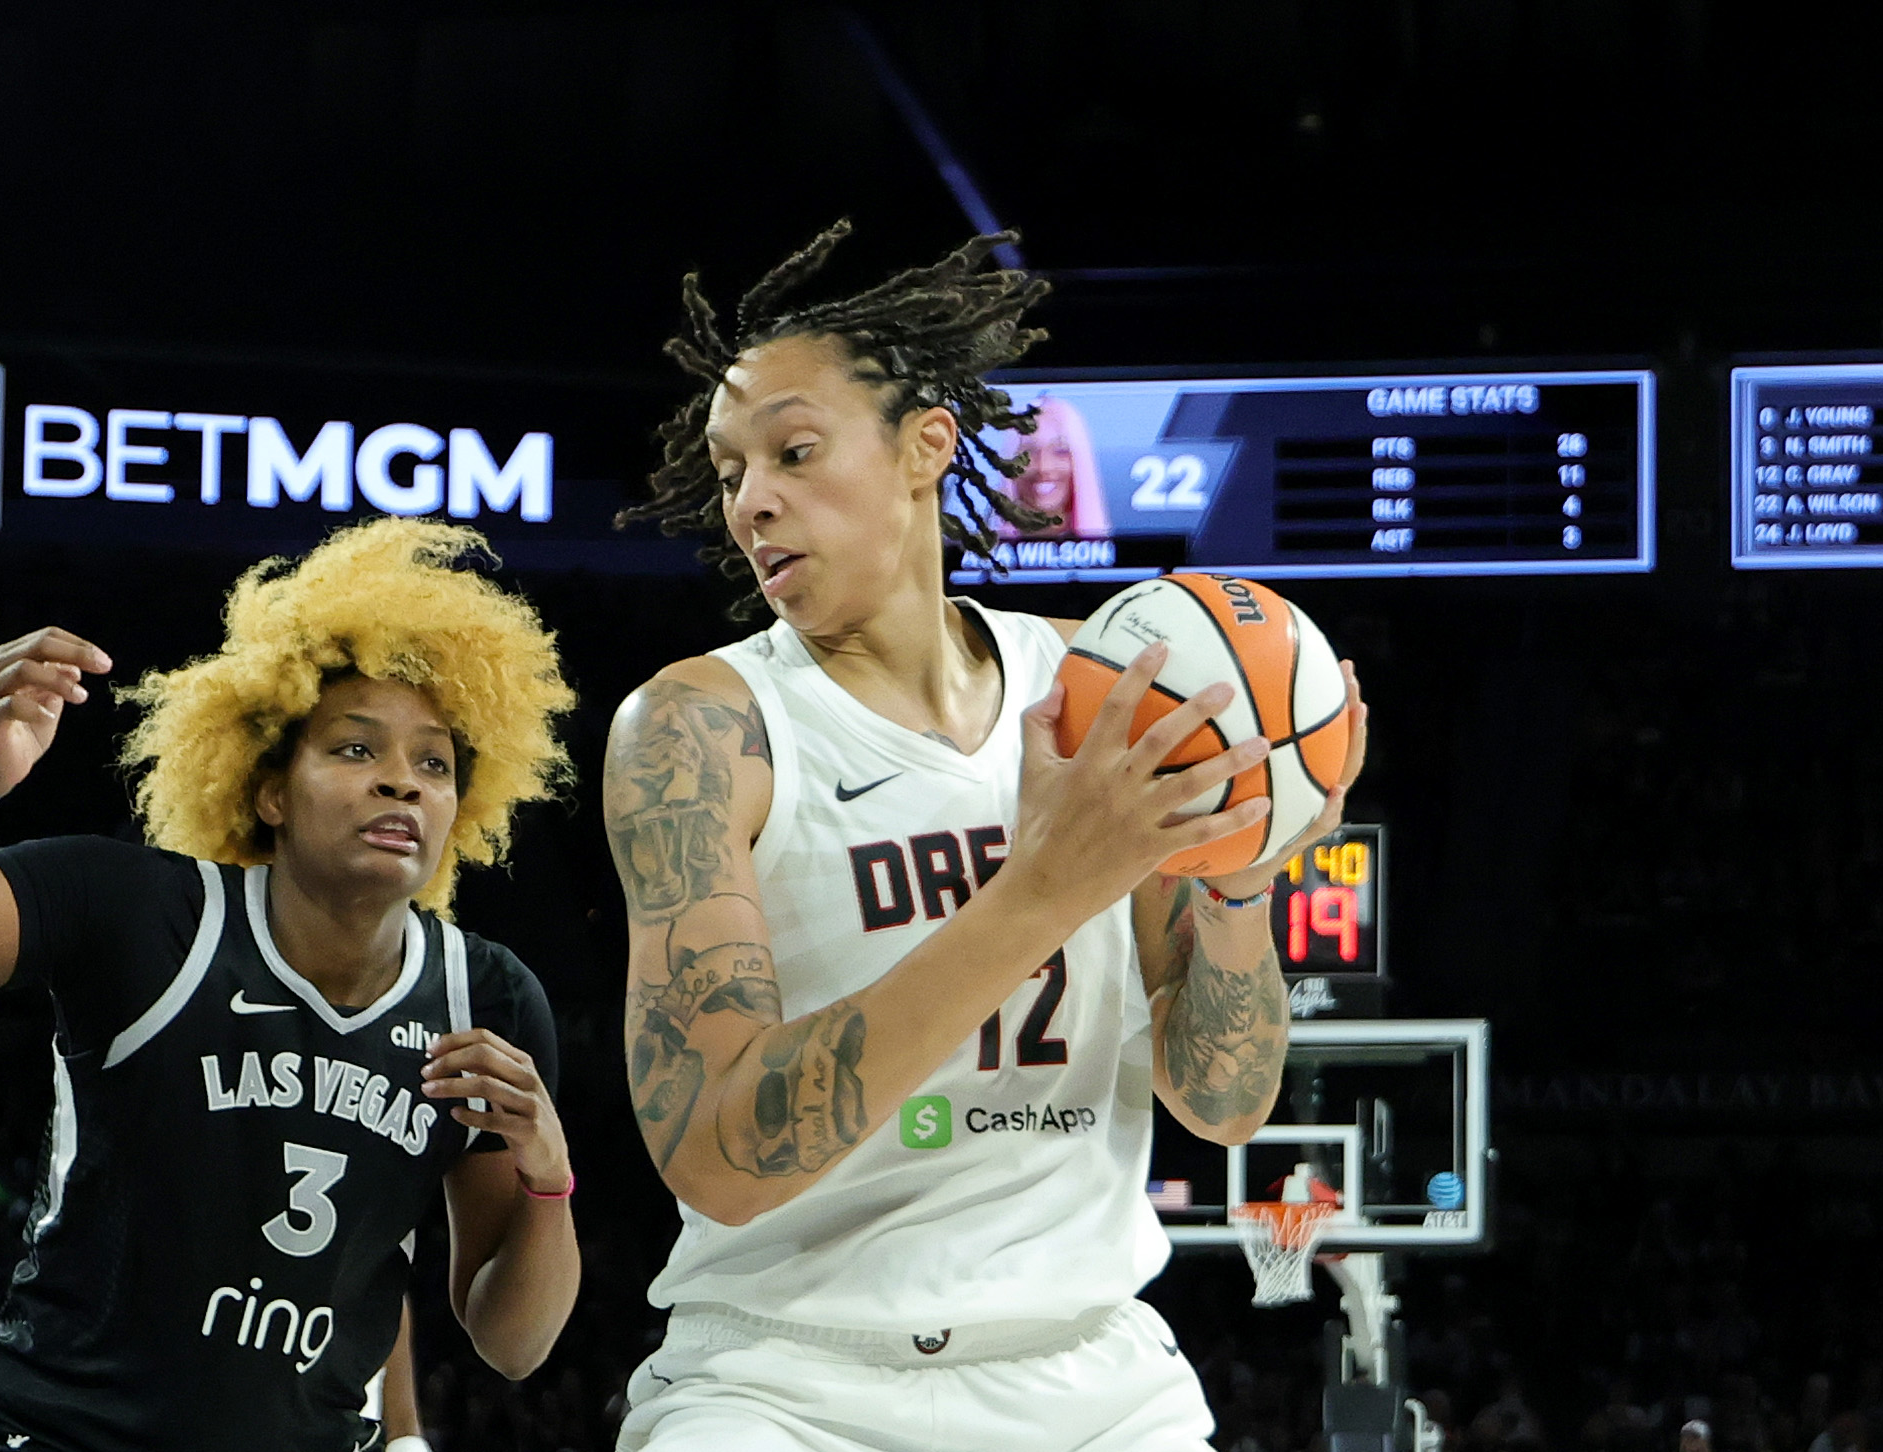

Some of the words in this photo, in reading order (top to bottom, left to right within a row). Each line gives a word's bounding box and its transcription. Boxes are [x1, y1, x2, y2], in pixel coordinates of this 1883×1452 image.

[1367, 387, 1449, 417] GAME
[1450, 385, 1540, 415] STATS
[1759, 407, 1777, 431] 0
[1805, 405, 1874, 428] YOUNG
[23, 404, 554, 522] BETMGM
[1808, 435, 1873, 459] SMITH
[1129, 453, 1210, 511] 22
[1755, 464, 1783, 489] 12
[1754, 494, 1784, 519] 22
[1807, 493, 1882, 516] WILSON
[1754, 523, 1784, 546] 24
[1805, 522, 1859, 546] LOYD
[1018, 541, 1116, 568] WILSON
[847, 825, 1011, 934] DRE
[1288, 887, 1359, 963] 19
[977, 945, 1068, 1071] 12
[201, 1051, 304, 1112] LAS
[314, 1055, 437, 1156] VEGAS
[261, 1141, 348, 1257] 3
[201, 1277, 335, 1375] ring
